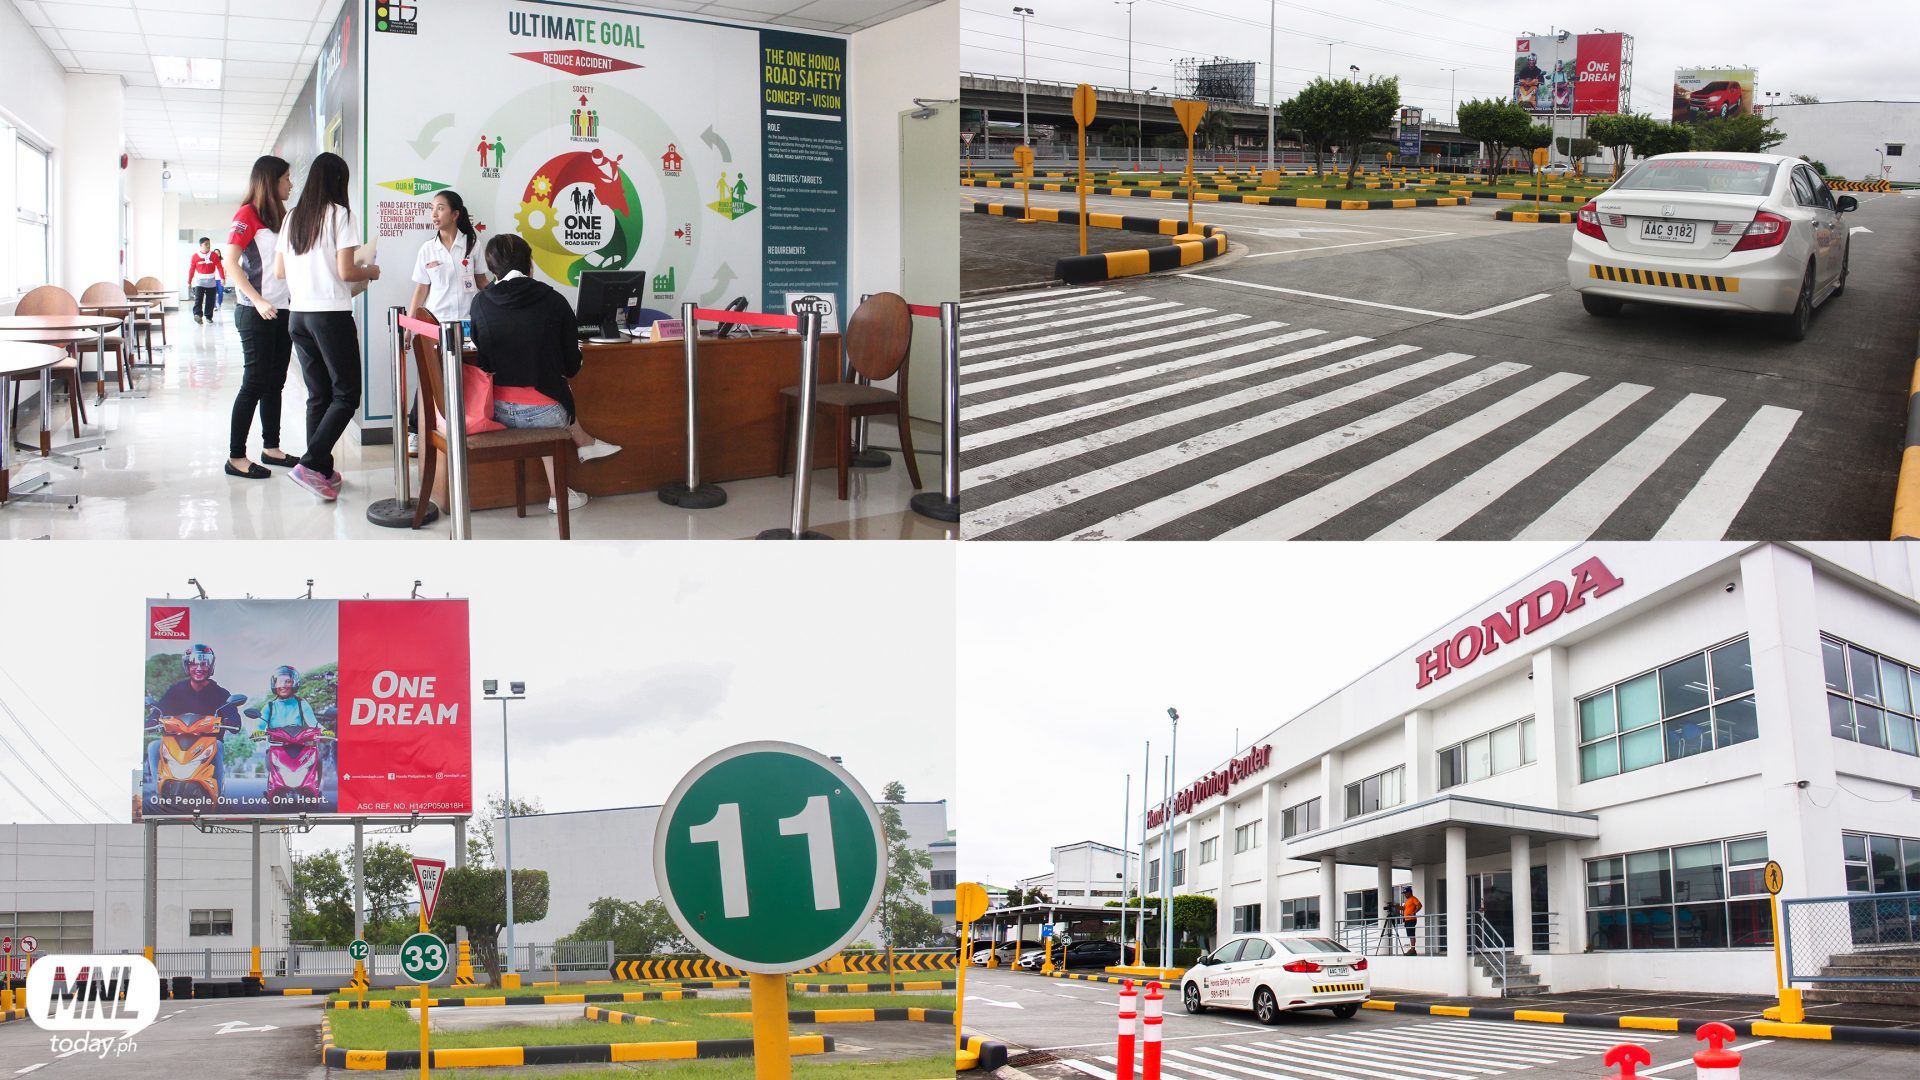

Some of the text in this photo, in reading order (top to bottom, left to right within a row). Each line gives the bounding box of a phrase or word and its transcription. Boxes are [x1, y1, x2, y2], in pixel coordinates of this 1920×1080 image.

[509, 11, 645, 49] ULTIMATE GOAL
[543, 53, 613, 70] REDUCE ACCIDENT
[765, 48, 840, 71] THE ONE HONDA
[765, 66, 841, 90] ROAD SAFETY
[572, 85, 594, 94] SOCIETY
[765, 89, 805, 106] CONCEPT
[812, 93, 841, 109] VISION
[767, 123, 780, 132] ROLE
[395, 182, 432, 191] OUR METHOD
[380, 201, 433, 210] ROAD SAFETY EDUC
[564, 215, 602, 230] ONE
[565, 230, 601, 240] Honda
[1645, 223, 1693, 238] AAC 9182
[768, 246, 806, 255] REQUIREMENTS
[1416, 555, 1624, 690] HONDA
[1193, 770, 1229, 803] Driving
[1228, 744, 1272, 784] Center
[150, 795, 329, 807] One People. One Love. One Heart.
[689, 795, 841, 919] 11
[422, 869, 436, 880] GIVE
[423, 881, 436, 891] WAY
[351, 944, 368, 956] 12
[405, 944, 444, 972] 33
